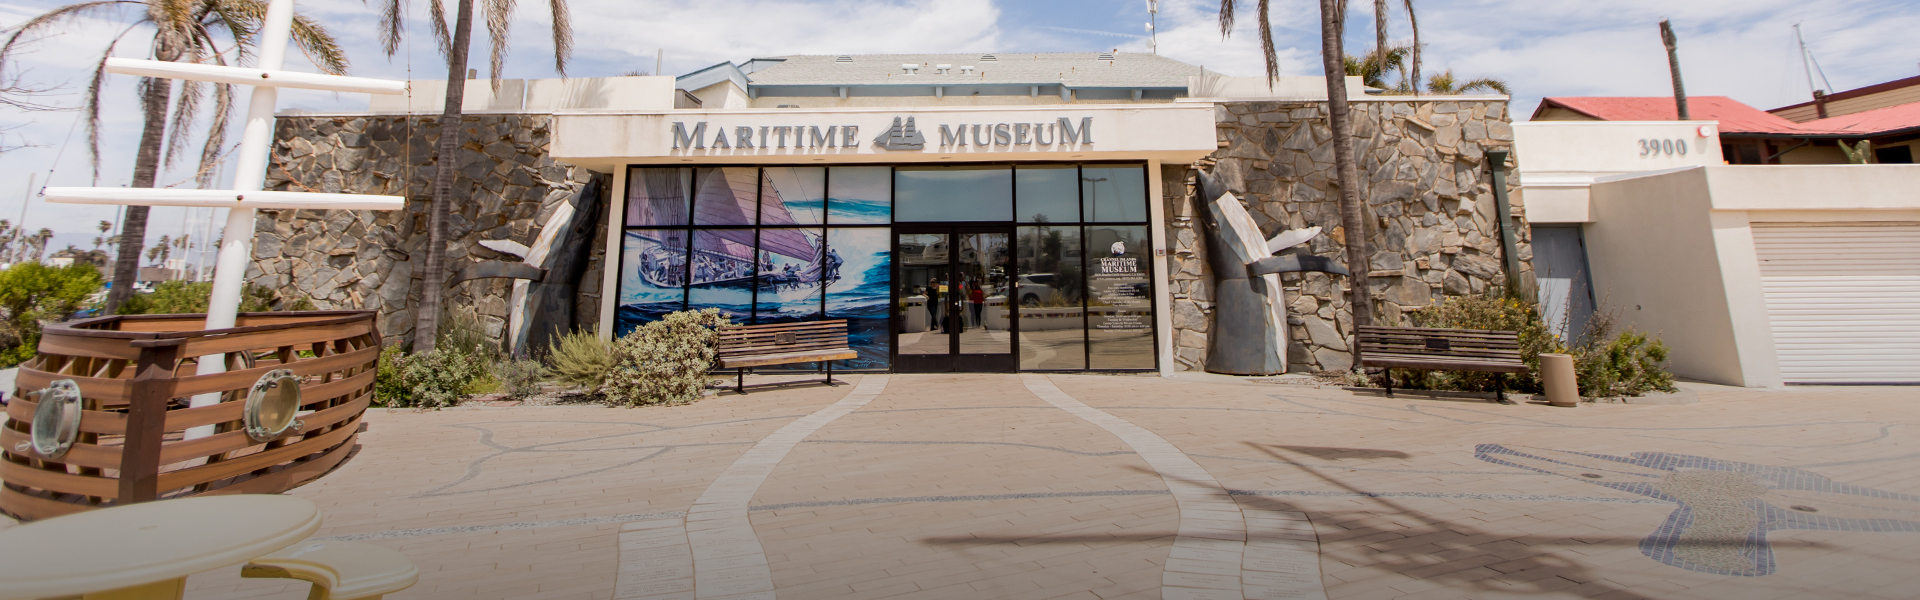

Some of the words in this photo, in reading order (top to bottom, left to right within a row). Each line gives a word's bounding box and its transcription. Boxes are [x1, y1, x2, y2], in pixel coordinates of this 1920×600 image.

[672, 121, 860, 150] MARITIME
[939, 116, 1094, 147] MUSEUM
[1637, 138, 1688, 157] 3900
